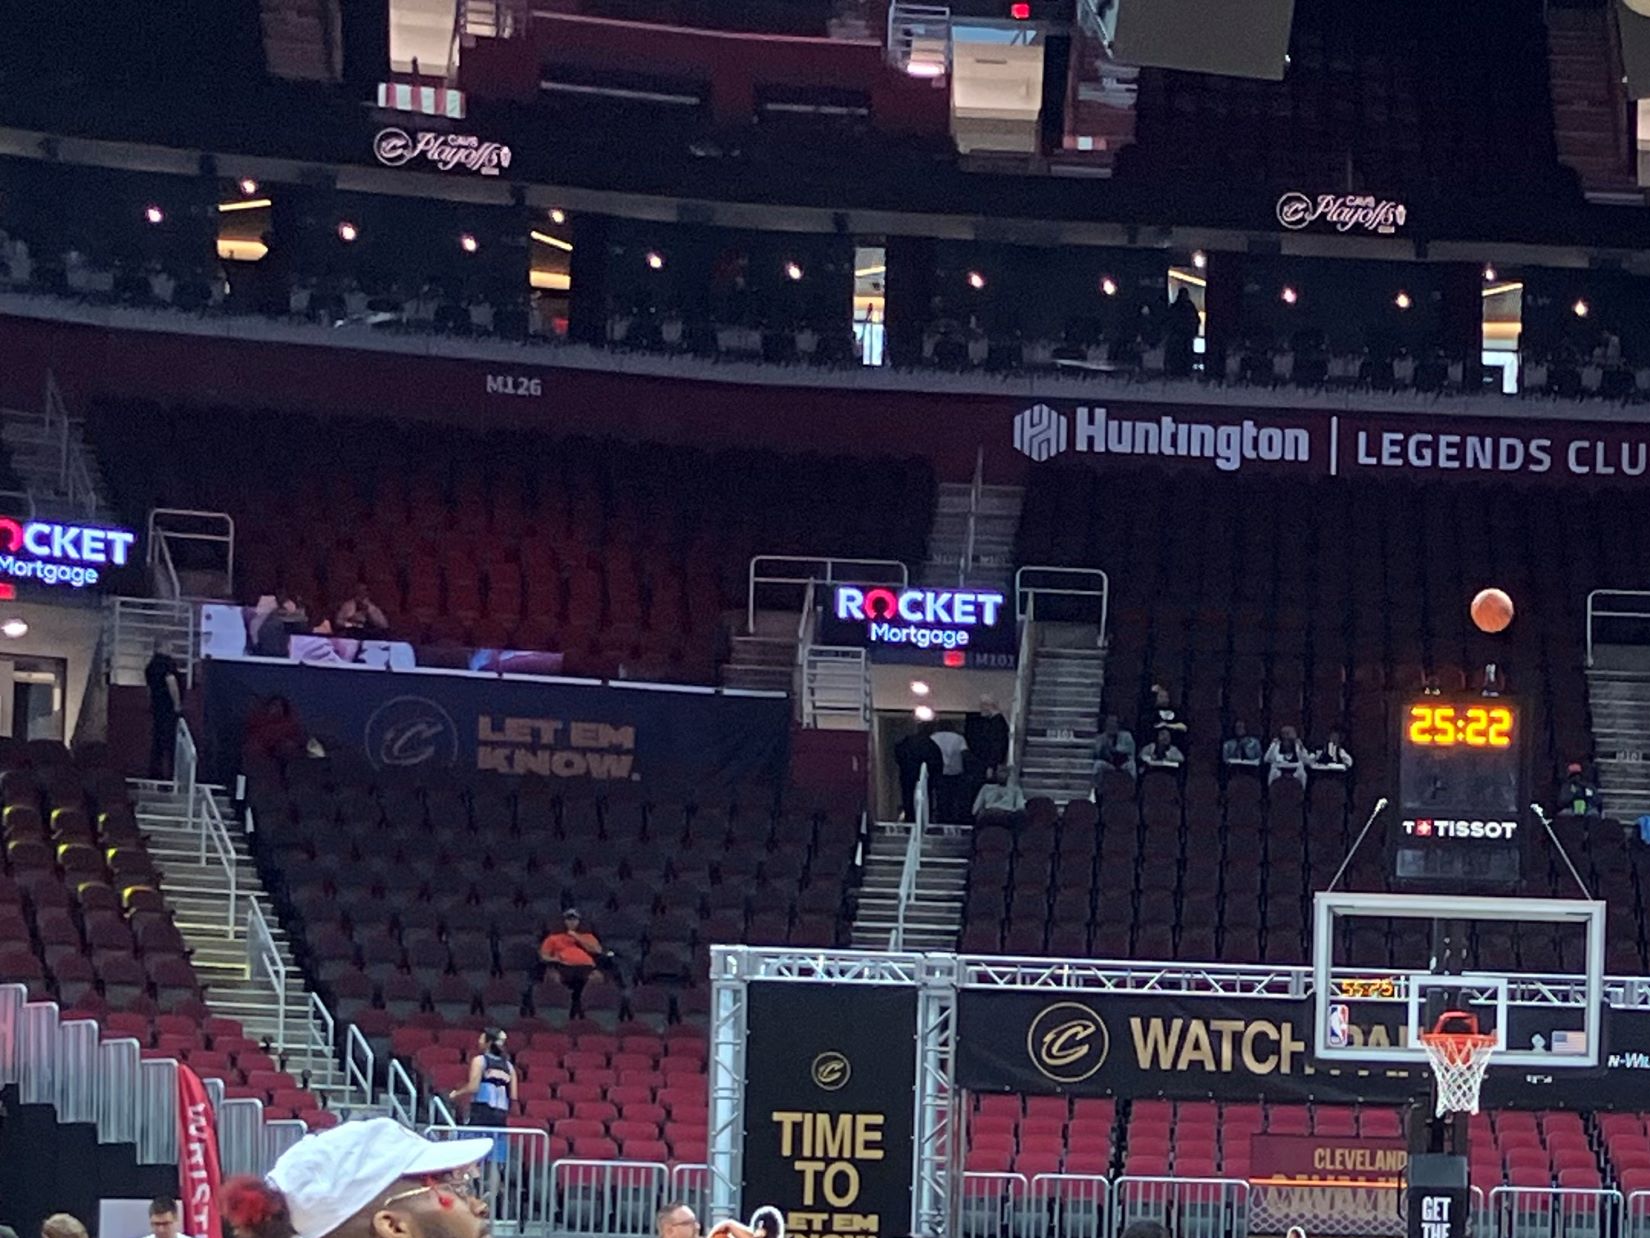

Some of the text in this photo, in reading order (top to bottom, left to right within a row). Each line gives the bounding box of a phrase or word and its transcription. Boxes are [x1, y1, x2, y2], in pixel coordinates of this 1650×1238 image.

[404, 132, 501, 170] Playoffs
[1305, 195, 1396, 231] Playoffs
[487, 374, 542, 396] M126
[1076, 407, 1310, 471] Huntington
[1358, 432, 1551, 473] LEGENDS
[0, 516, 134, 565] OCKET
[837, 588, 1003, 626] ROCKET
[870, 622, 969, 648] Mortgage
[478, 715, 563, 744] LET
[570, 721, 635, 749] EM
[1409, 706, 1513, 746] 25:22
[1434, 820, 1518, 839] TISSOT
[771, 1111, 885, 1160] TIME
[1313, 1148, 1408, 1172] CLEVELAND
[793, 1160, 860, 1208] TO
[785, 1212, 879, 1232] ET EM
[1421, 1196, 1452, 1222] GET
